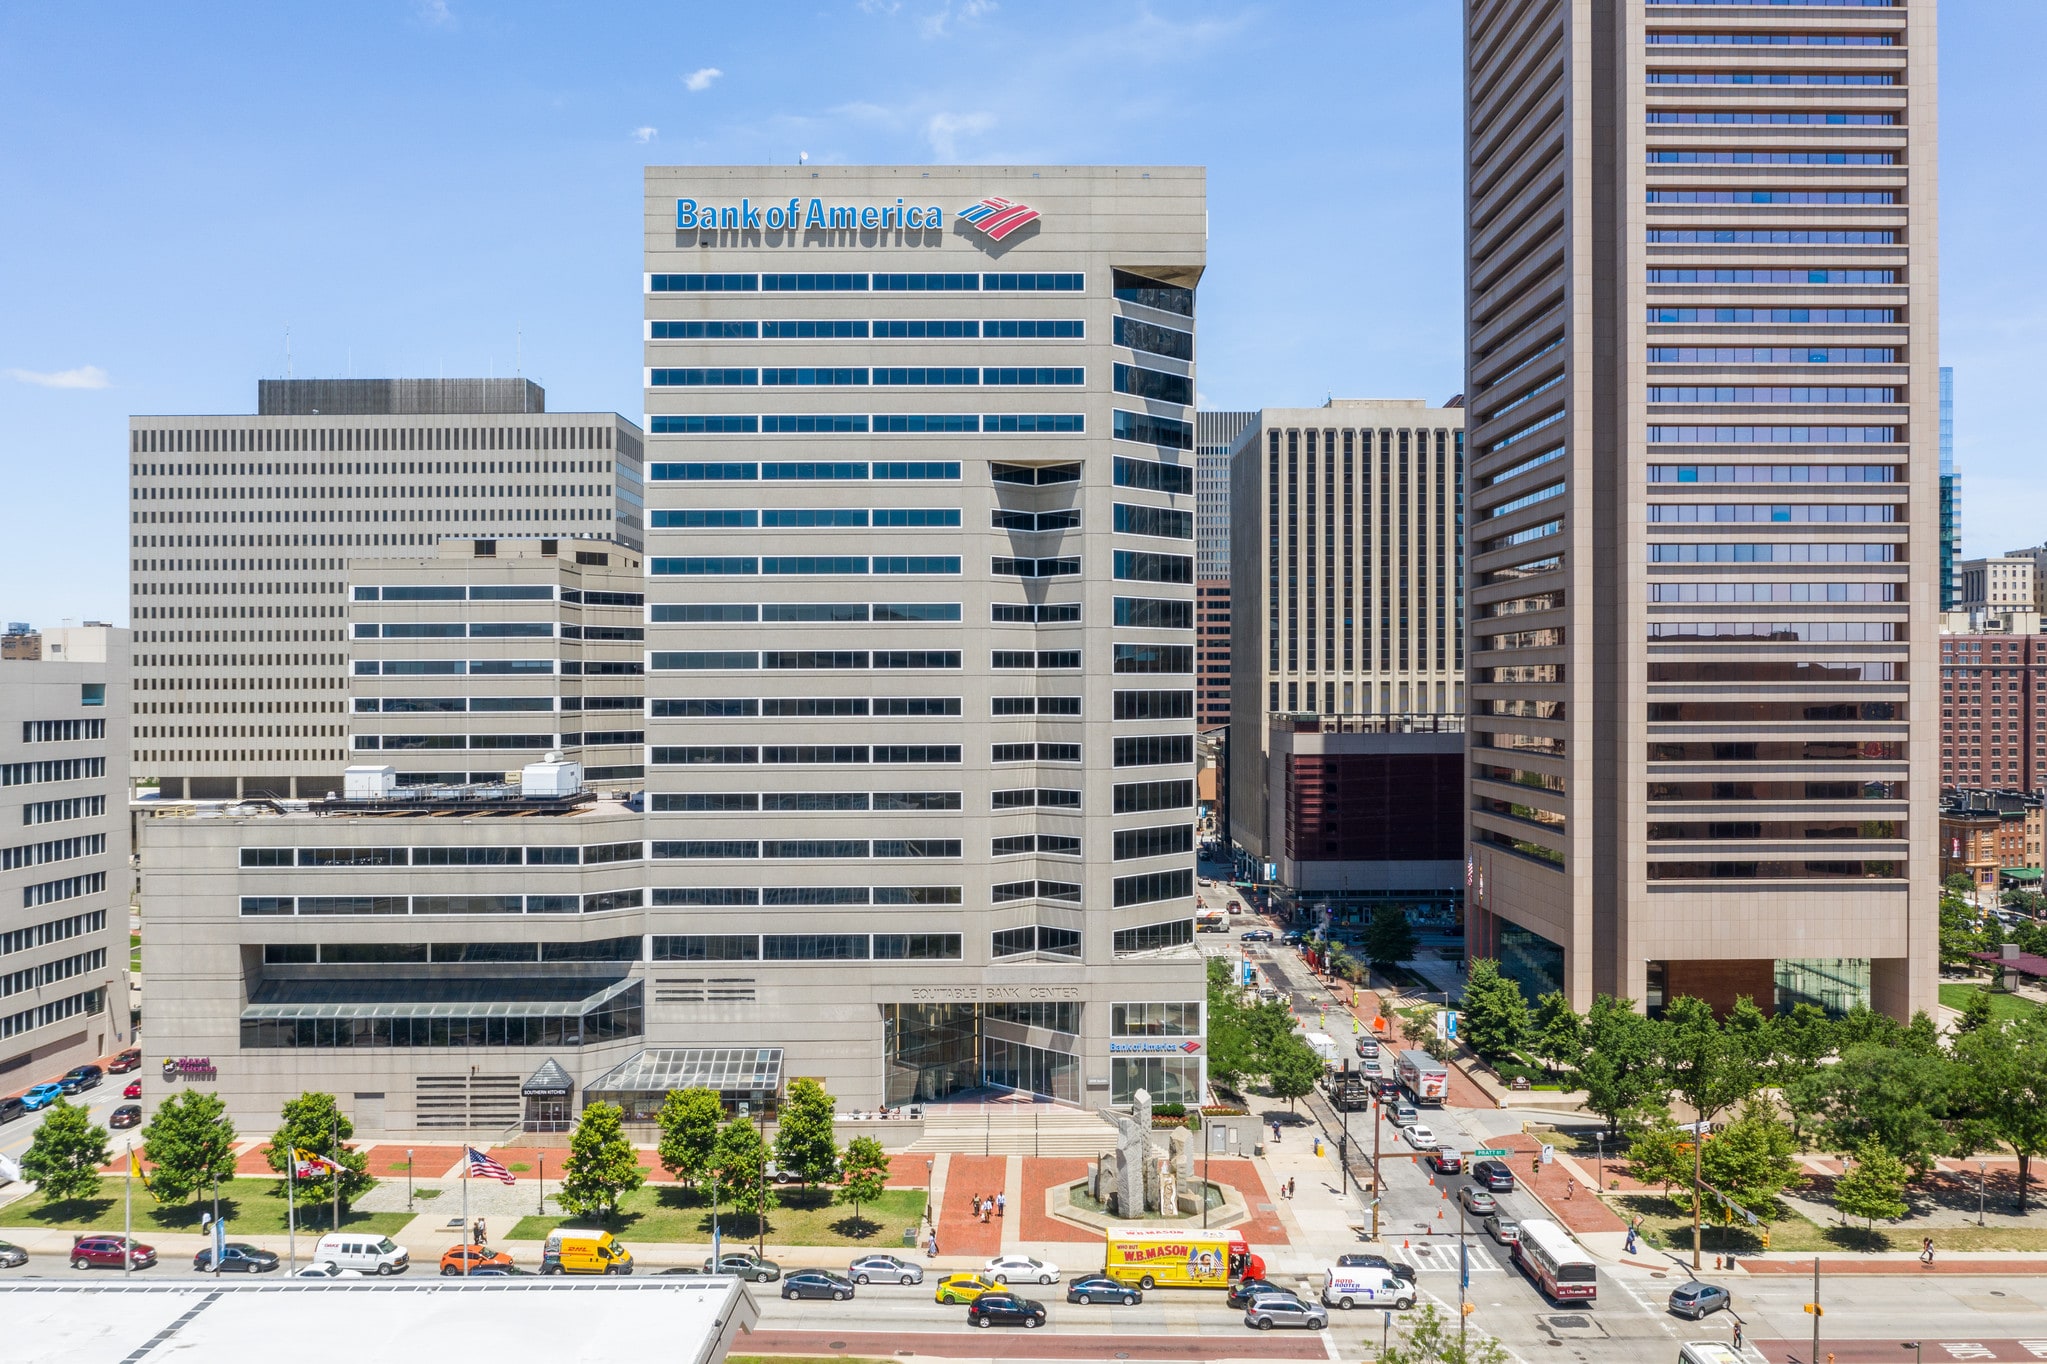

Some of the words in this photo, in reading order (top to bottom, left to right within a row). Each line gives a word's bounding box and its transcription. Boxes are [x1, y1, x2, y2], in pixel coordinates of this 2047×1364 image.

[676, 198, 760, 229] Bank
[766, 198, 800, 229] of
[805, 198, 943, 229] America
[912, 988, 977, 999] EQUITABLE
[986, 988, 1020, 998] BANK
[1029, 987, 1079, 998] CENTER
[1110, 1042, 1131, 1052] Bank
[1132, 1042, 1141, 1052] of
[1142, 1042, 1177, 1052] America
